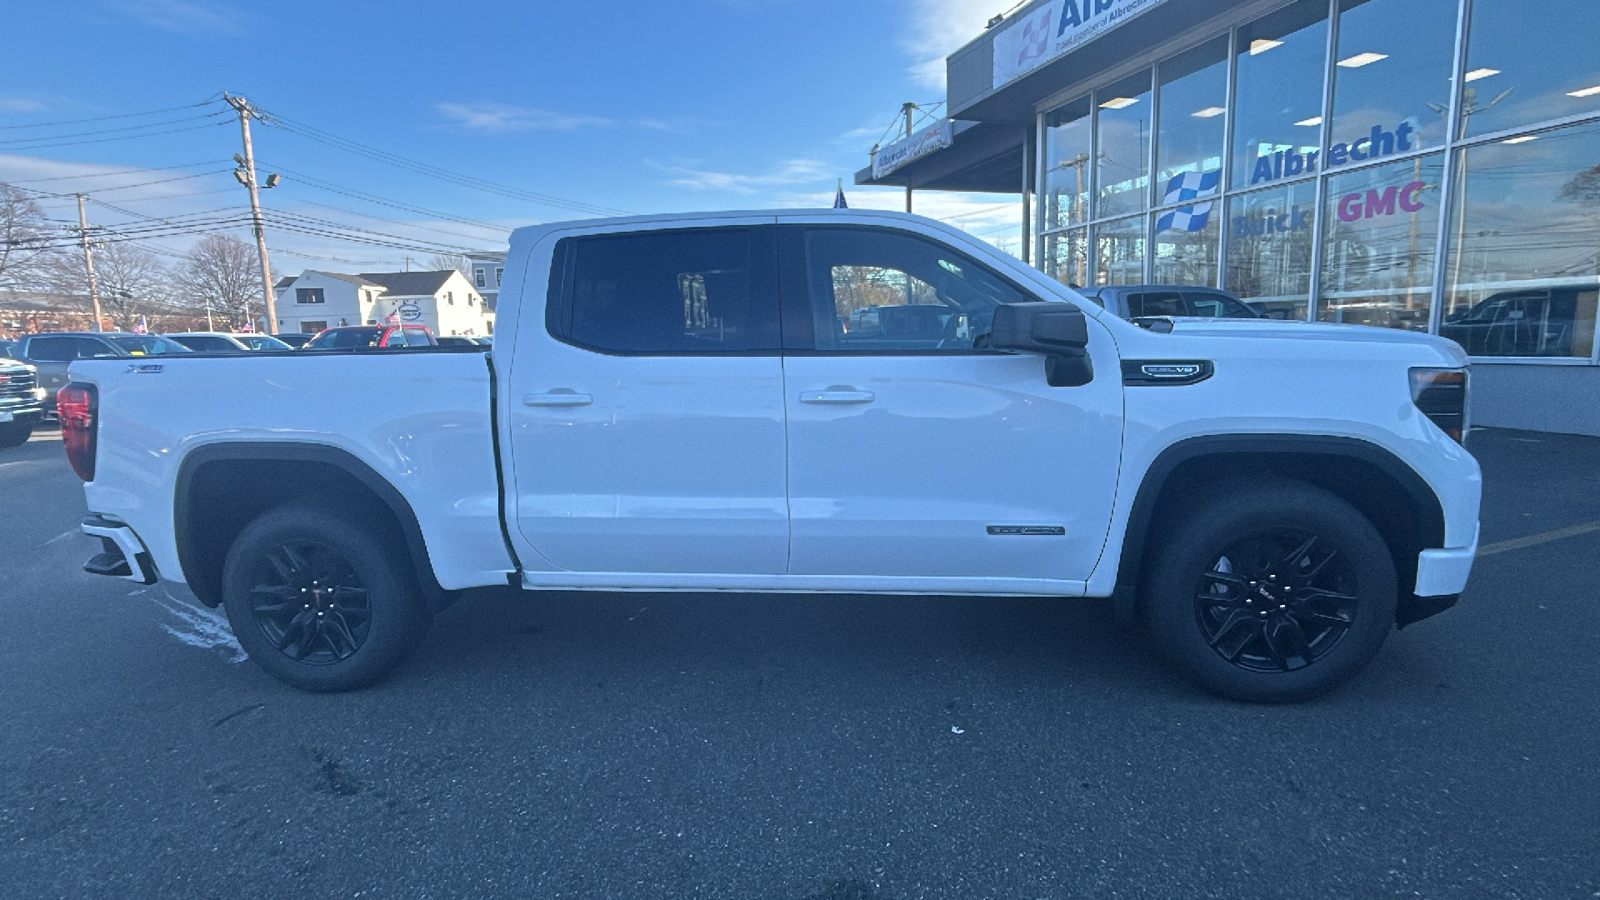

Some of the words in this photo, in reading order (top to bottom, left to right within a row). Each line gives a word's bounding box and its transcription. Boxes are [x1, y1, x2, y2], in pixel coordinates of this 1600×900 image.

[1073, 21, 1100, 42] member
[1252, 121, 1412, 184] Albrecht
[1233, 205, 1309, 239] Buick
[1338, 181, 1426, 222] GMC
